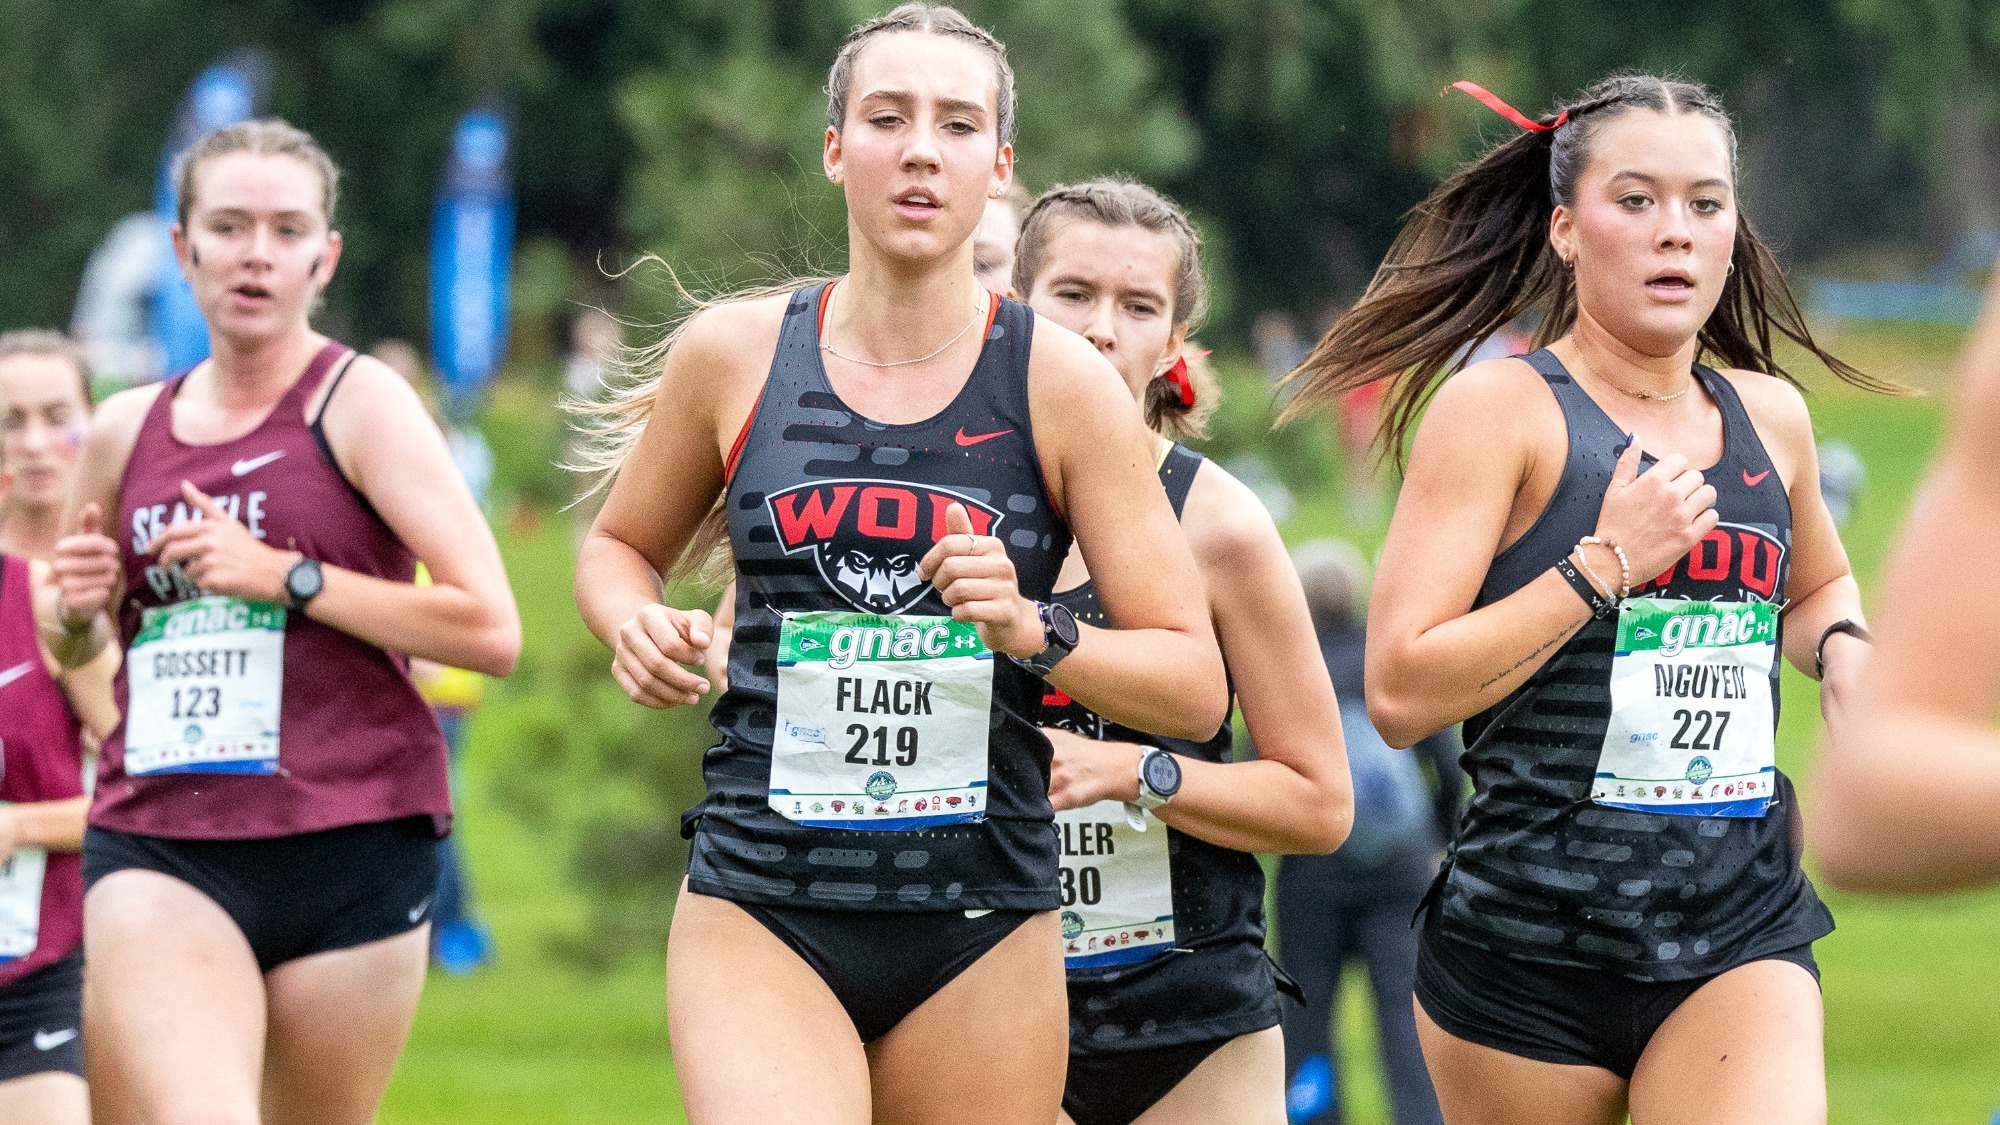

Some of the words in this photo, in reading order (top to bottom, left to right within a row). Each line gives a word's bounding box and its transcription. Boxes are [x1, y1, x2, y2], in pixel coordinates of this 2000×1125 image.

[1635, 529, 1780, 597] OU
[828, 625, 949, 670] gnac
[1659, 611, 1756, 657] gnac
[154, 650, 249, 680] GOSSETT
[1654, 663, 1747, 700] NGUYEN
[172, 686, 221, 719] 123
[836, 676, 933, 716] FLACK
[845, 723, 919, 767] 219
[1670, 709, 1731, 750] 227
[1059, 822, 1115, 856] LER
